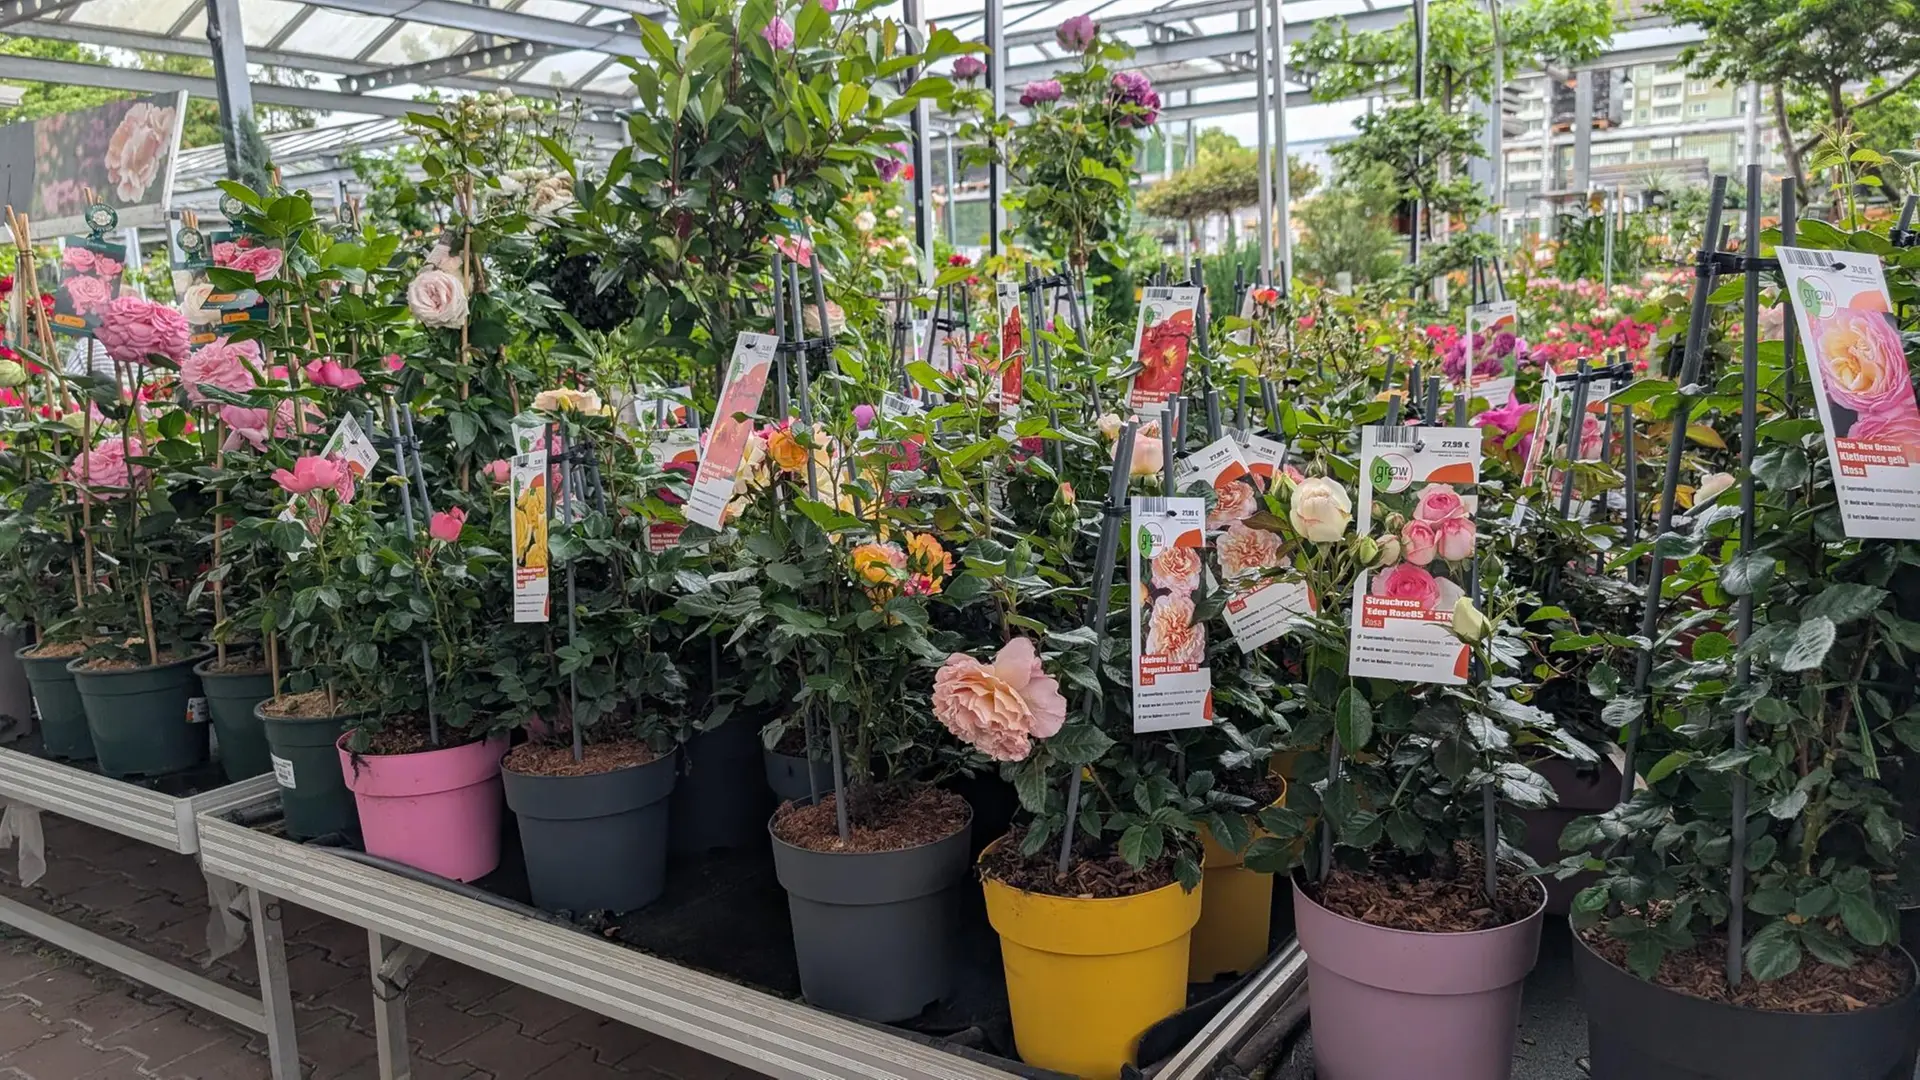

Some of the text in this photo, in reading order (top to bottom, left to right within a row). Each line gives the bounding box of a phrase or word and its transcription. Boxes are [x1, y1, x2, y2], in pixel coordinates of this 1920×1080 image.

[1803, 288, 1832, 308] grow
[1837, 440, 1856, 449] Rose
[1209, 450, 1225, 461] 27,99
[1839, 452, 1906, 465] Kletterrose gelb
[1374, 466, 1409, 483] grow
[1841, 465, 1865, 475] Rosa
[1141, 534, 1163, 551] grow
[1365, 596, 1421, 608] Strauchrose
[1365, 607, 1388, 616] 'Eden
[1364, 618, 1383, 627] Rosa
[1141, 656, 1167, 664] Edelrose
